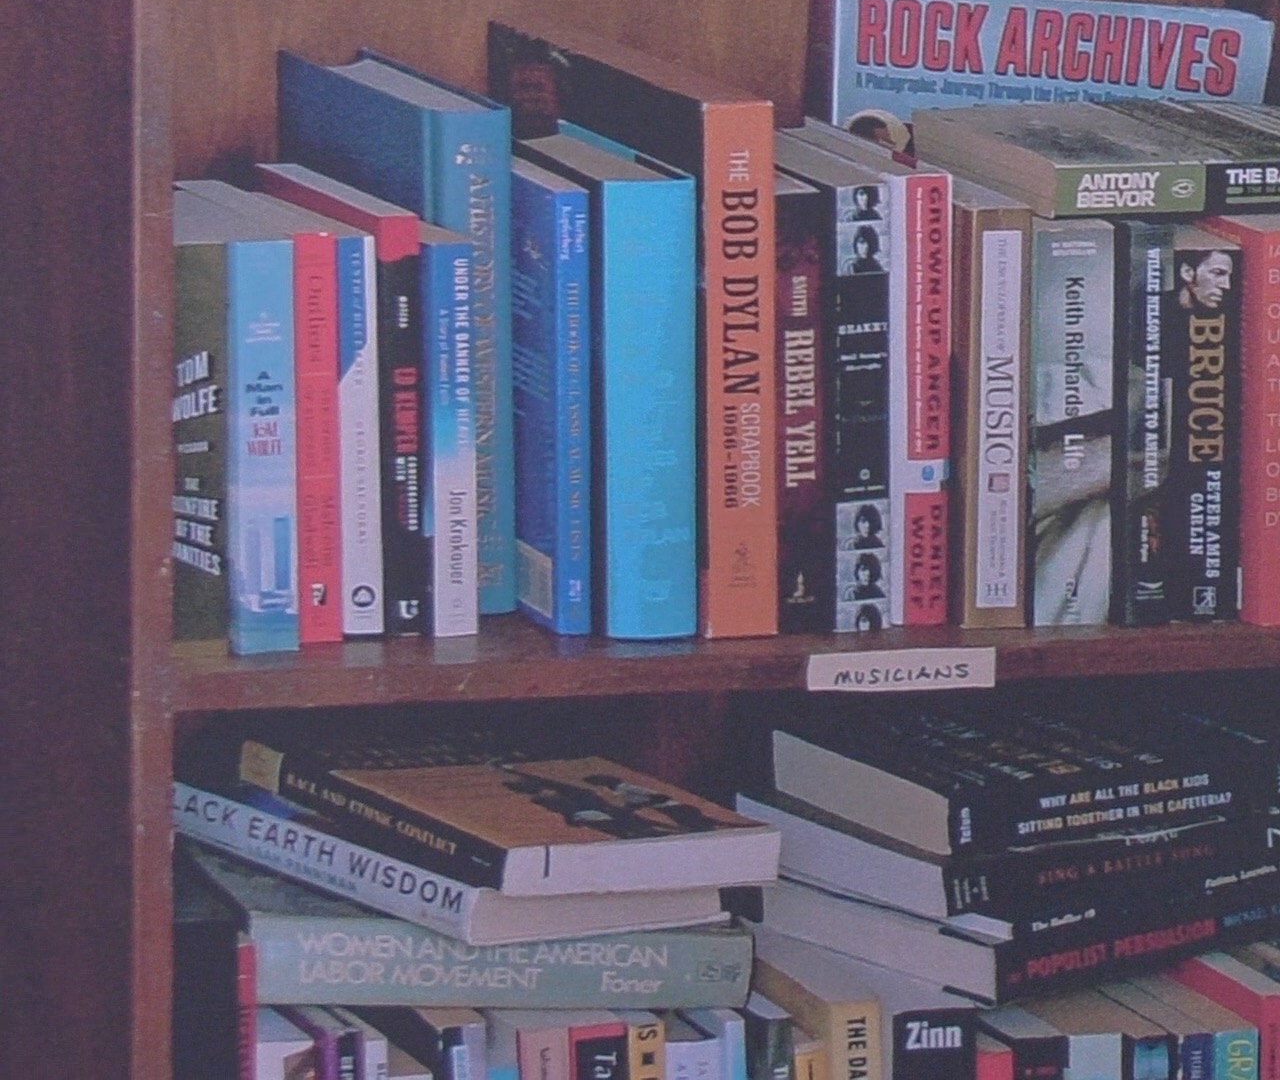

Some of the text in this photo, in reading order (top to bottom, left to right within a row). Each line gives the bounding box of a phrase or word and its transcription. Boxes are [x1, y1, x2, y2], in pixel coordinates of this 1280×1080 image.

[994, 6, 1242, 98] ARCHIVES
[1076, 188, 1156, 210] BEEVOR
[1079, 171, 1160, 193] ANTONY
[1226, 168, 1262, 185] THE
[721, 150, 761, 396] THE BOB DYLAN
[926, 186, 943, 452] GROWN-UP ANGER
[1064, 276, 1086, 327] Keith
[453, 258, 471, 402] UNDER THE BANNER OF
[176, 350, 210, 387] TOM
[785, 275, 816, 489] SMITH REBEL YELL
[1063, 331, 1086, 418] Richards
[1144, 248, 1162, 489] WILLIE NELSON'S LETTERS TO AMERICA
[1267, 353, 1280, 369] A
[245, 382, 284, 394] Man
[249, 404, 279, 418] Full
[984, 355, 1015, 466] MUSIC
[1188, 314, 1226, 463] BRUCE
[740, 402, 761, 508] SCRAPBOOK
[1063, 433, 1085, 472] Life
[448, 490, 467, 516] Jon
[1189, 492, 1205, 556] CARLIN
[1204, 470, 1222, 579] PETER AMES
[910, 515, 925, 610] WOLFF
[928, 505, 943, 609] DANIEL
[834, 663, 969, 686] MUSICIANS
[1017, 790, 1233, 836] SITTING TOGETHER IN THE CAFETERIA?
[1039, 773, 1210, 809] WHY ARE ALL THE BLACK KIDS
[958, 806, 972, 845] Tatum
[247, 814, 337, 867] EARTH
[347, 850, 464, 914] WISDOM
[298, 931, 668, 968] WOMEN AND THE AMERICAN
[300, 959, 542, 990] LABOR MOVEMENT
[600, 973, 662, 995] Foner
[905, 1021, 963, 1050] Zinn
